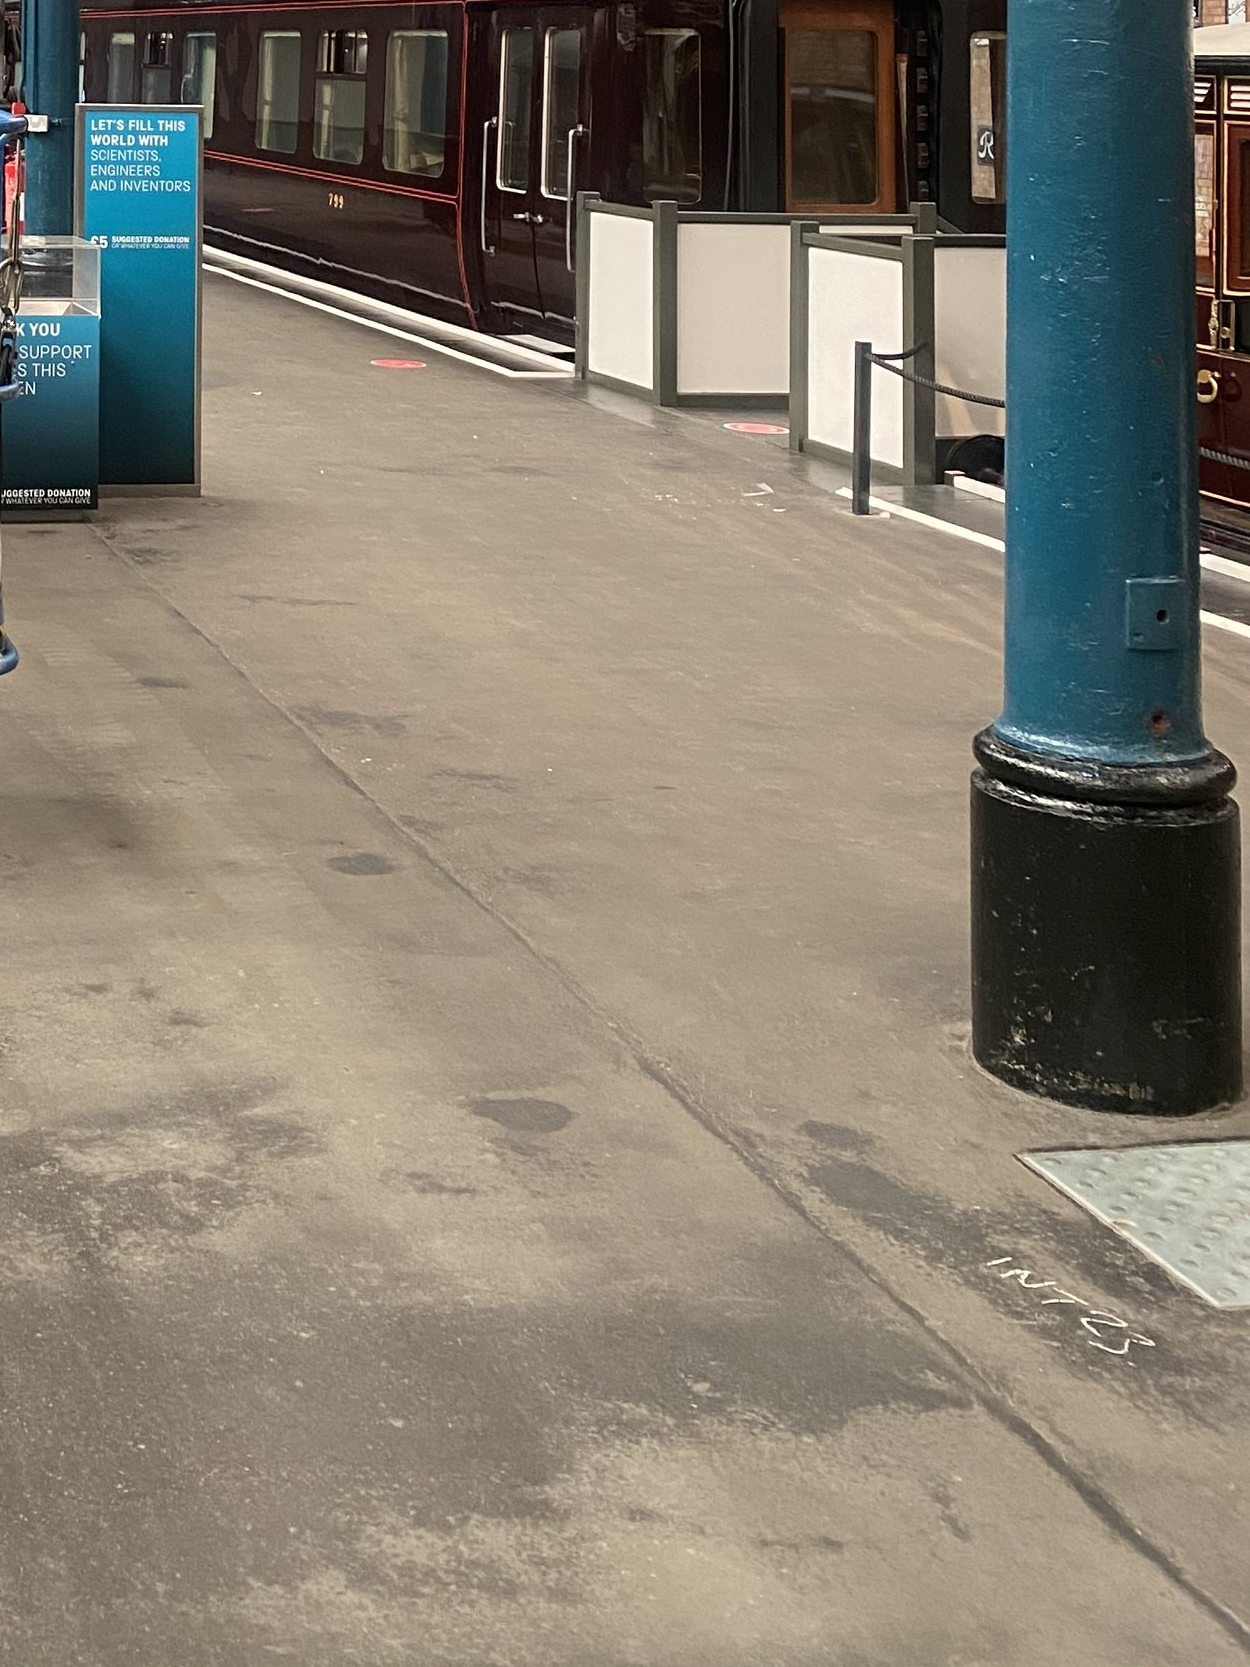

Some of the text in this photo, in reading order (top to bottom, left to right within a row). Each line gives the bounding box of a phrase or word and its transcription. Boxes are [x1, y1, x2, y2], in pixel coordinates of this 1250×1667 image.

[91, 119, 186, 131] LET'S FILL THIS
[91, 135, 168, 146] WORLD WITH
[90, 164, 160, 176] ENGINEERS
[90, 180, 191, 192] AND INVENTORS
[29, 323, 61, 337] YOU
[19, 345, 92, 359] SUPPORT
[32, 363, 66, 377] THIS
[1, 489, 44, 497] UGGESTED
[48, 489, 90, 497] DONATION
